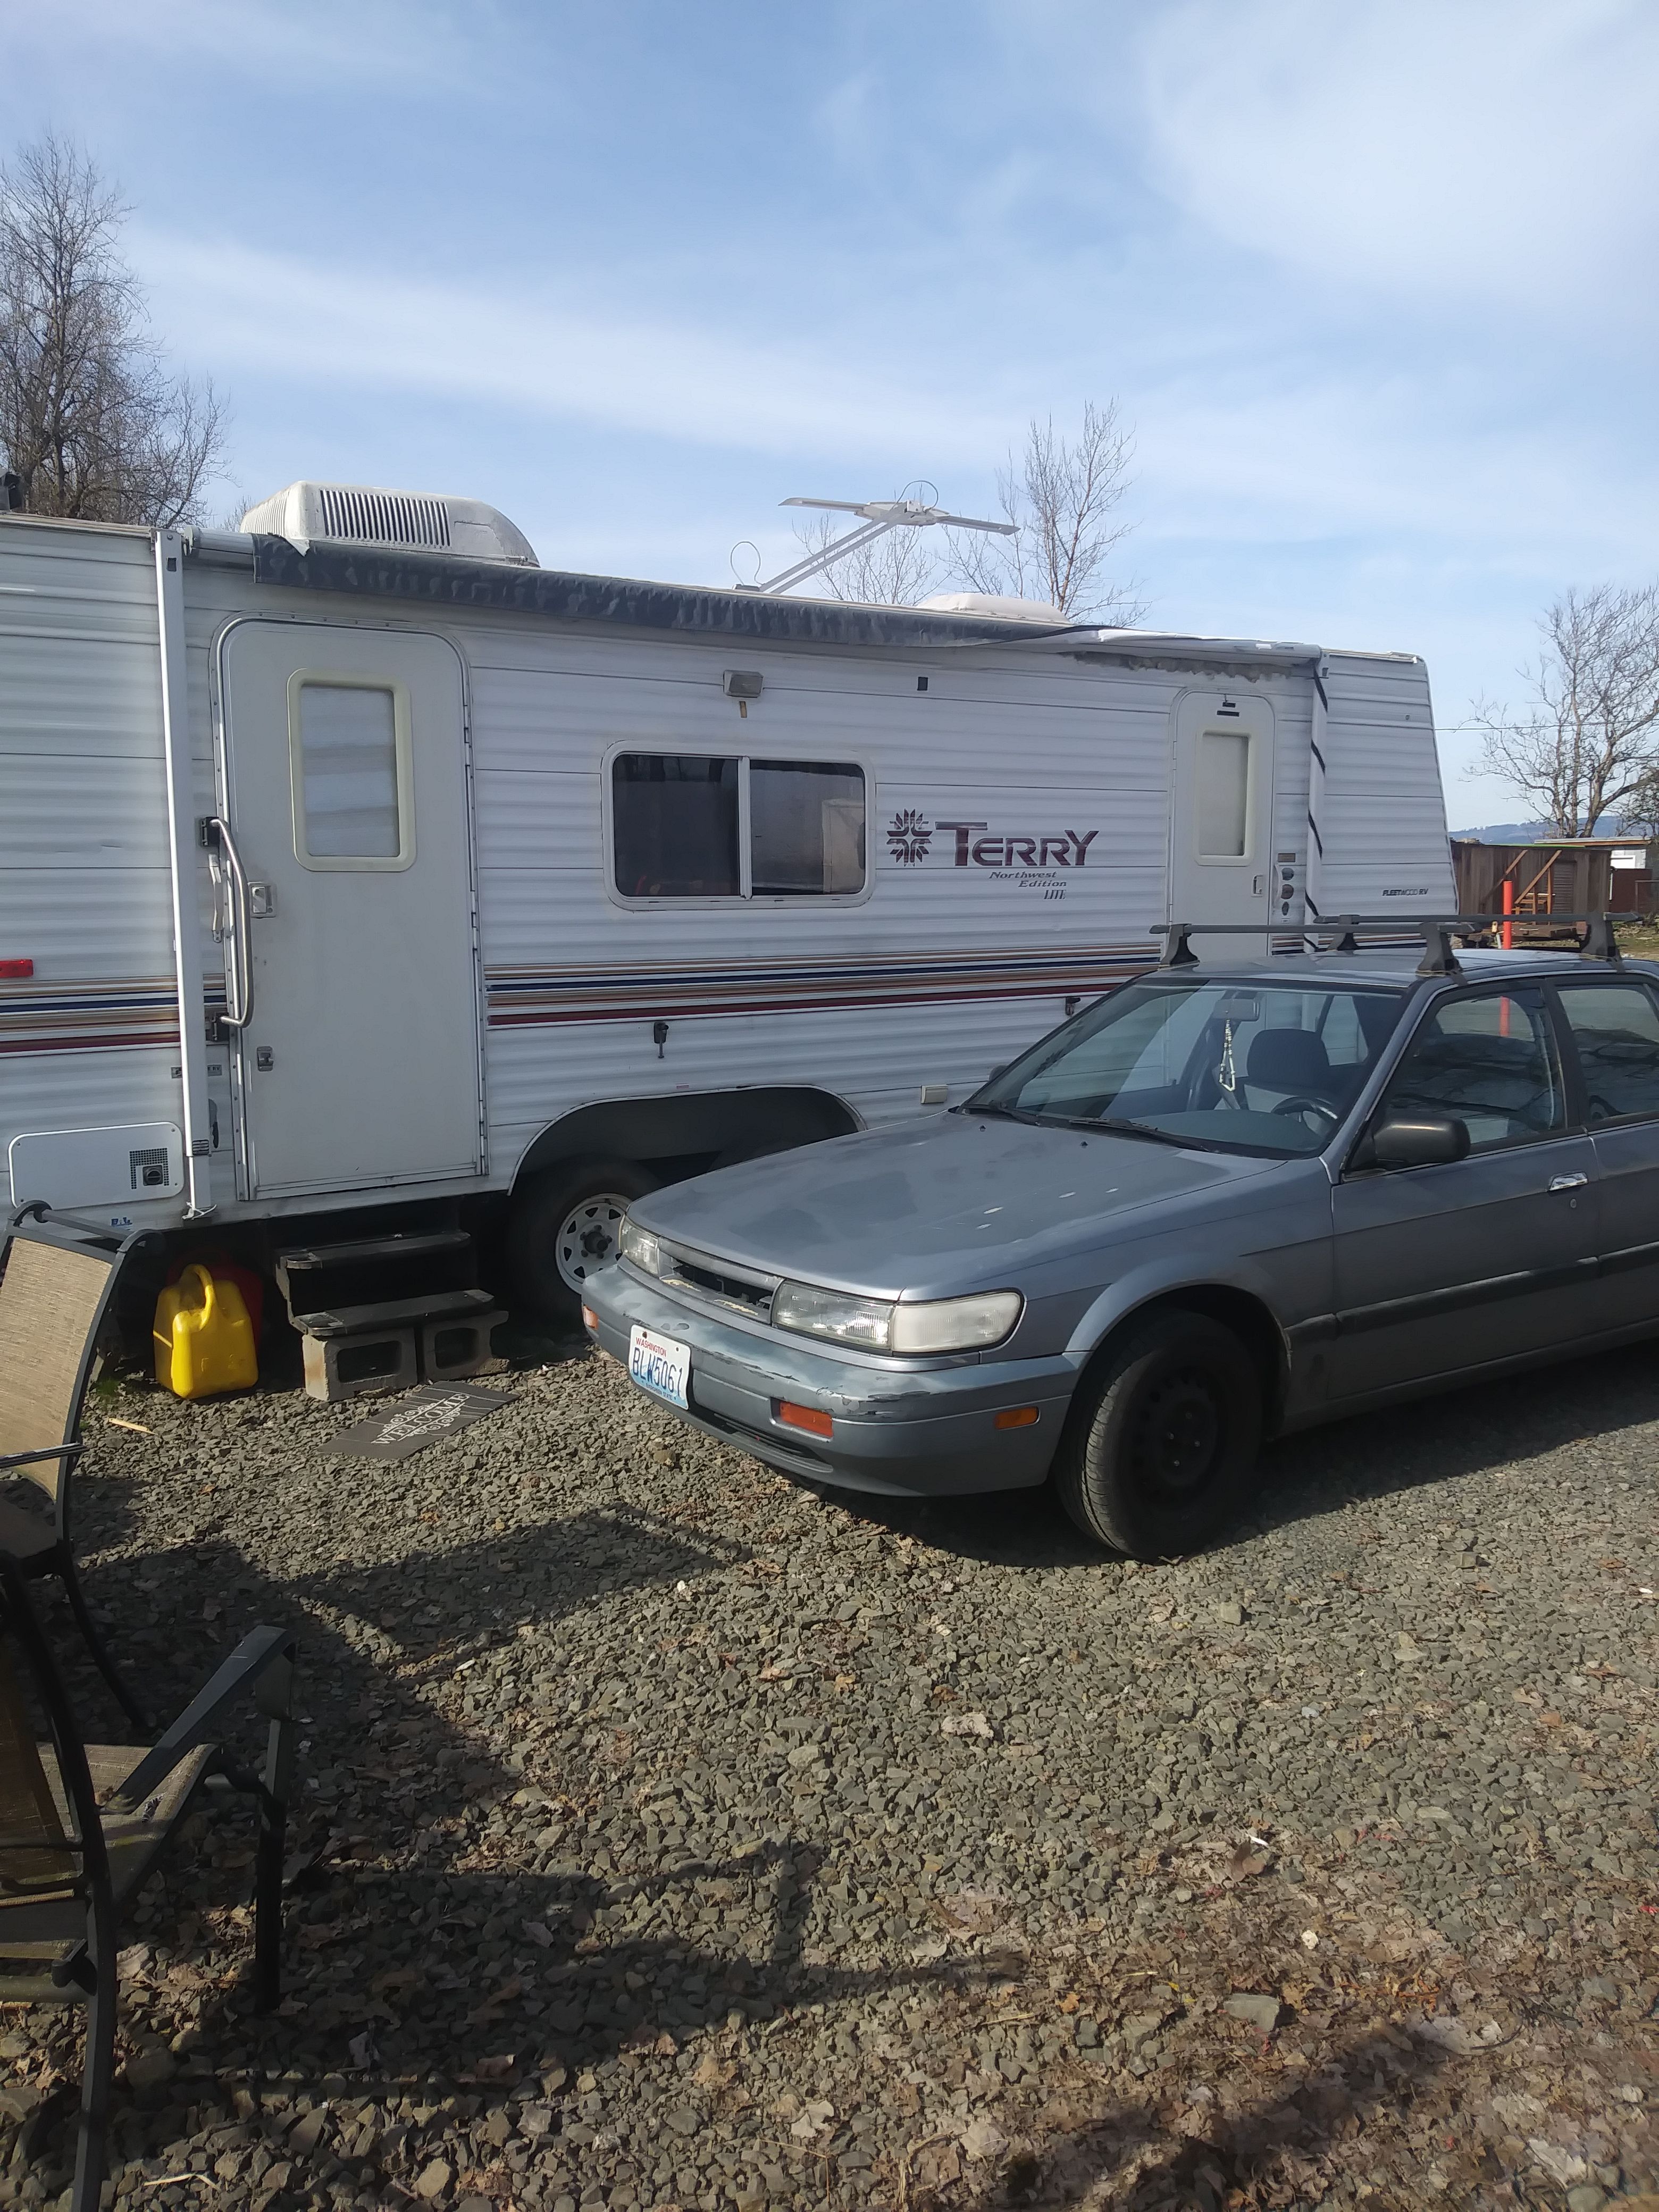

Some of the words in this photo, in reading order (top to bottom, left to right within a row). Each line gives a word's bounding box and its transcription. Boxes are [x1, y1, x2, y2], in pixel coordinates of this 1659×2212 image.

[935, 822, 1100, 867] TERRY
[635, 1337, 667, 1357] WASHINGTON
[633, 1346, 683, 1397] BLW5061
[371, 1393, 471, 1444] WELCOME
